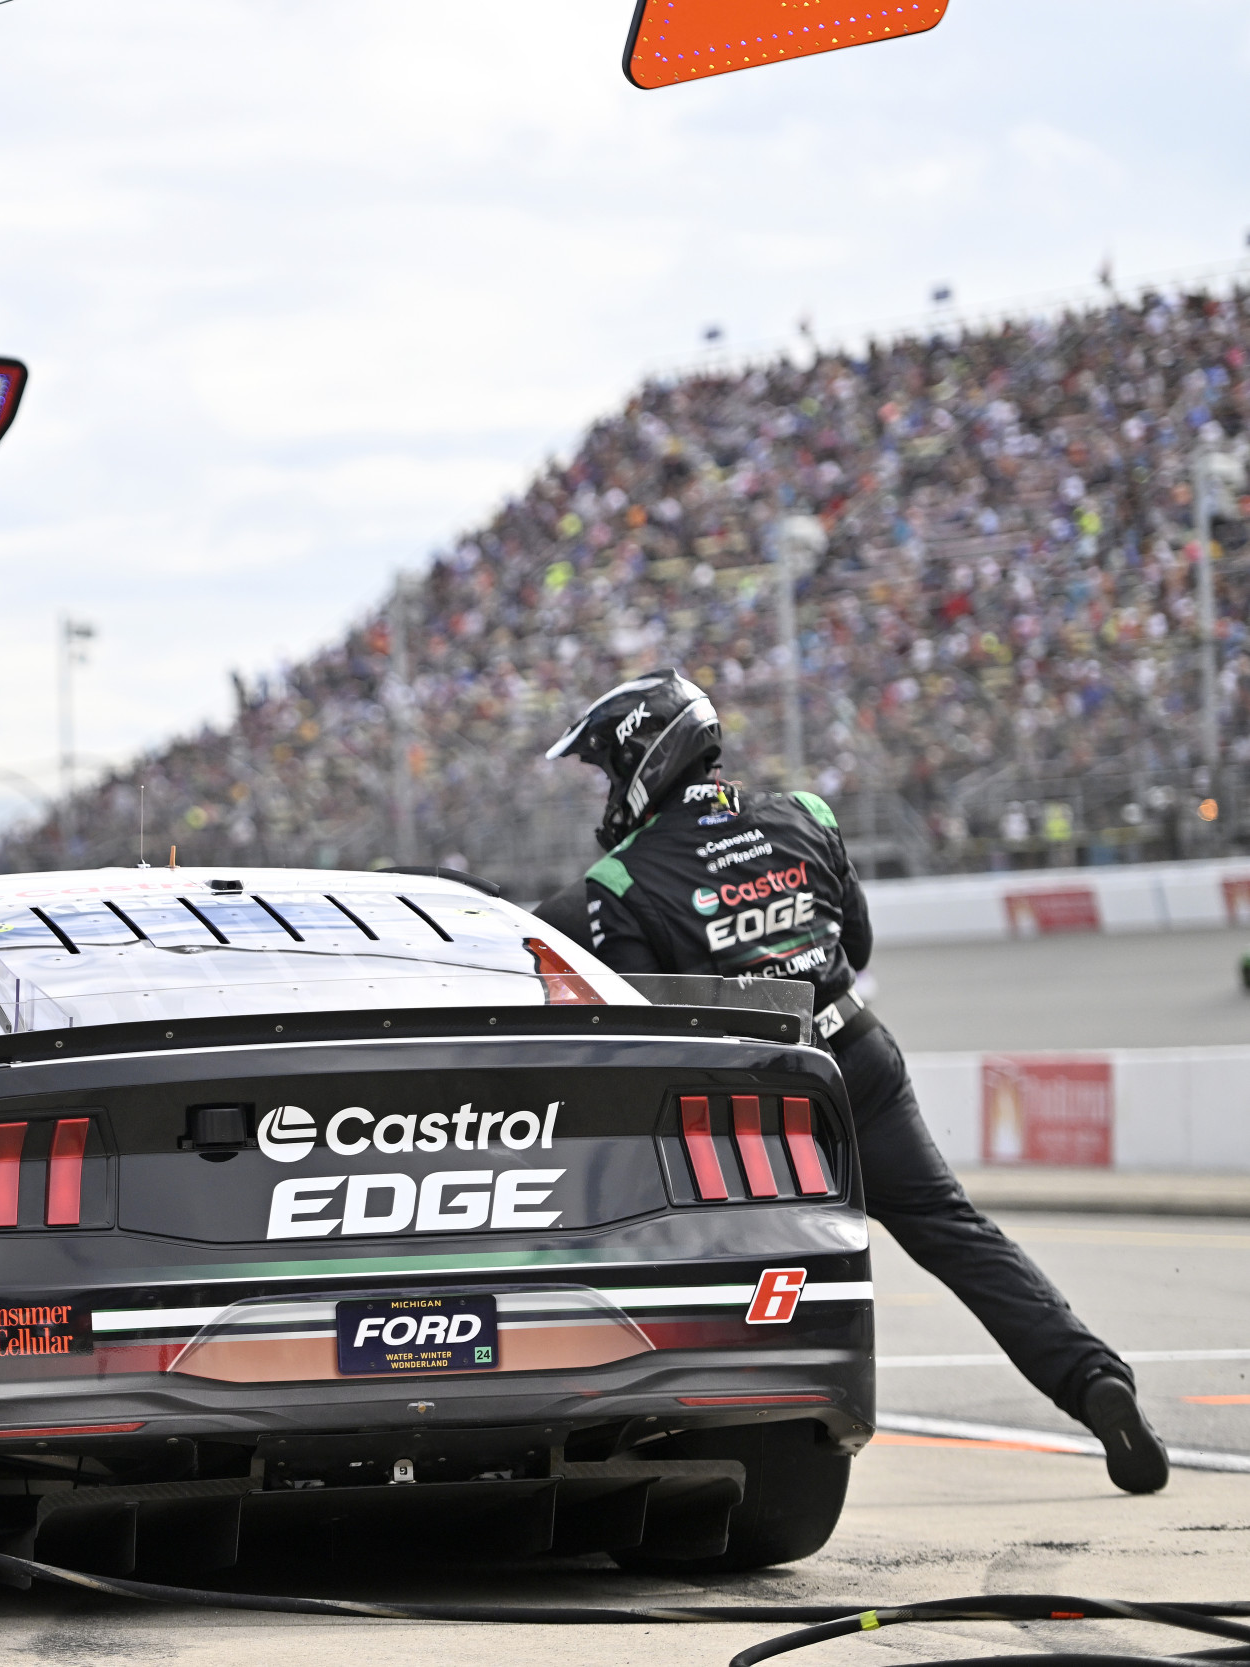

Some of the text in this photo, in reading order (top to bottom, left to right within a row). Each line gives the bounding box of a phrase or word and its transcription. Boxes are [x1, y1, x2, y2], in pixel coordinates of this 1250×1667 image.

[615, 701, 651, 745] RFK
[15, 882, 207, 898] Castro
[720, 861, 809, 906] Castrol
[705, 892, 816, 952] EDGE
[325, 1101, 560, 1156] Castrol
[266, 1168, 568, 1240] EDGE
[391, 1299, 442, 1309] MICHIGAN
[747, 1269, 806, 1323] 6
[353, 1313, 482, 1347] FORD
[385, 1352, 413, 1361] WATER
[420, 1351, 452, 1360] WINTER
[391, 1359, 448, 1369] WONDERLAND
[476, 1349, 491, 1360] 24
